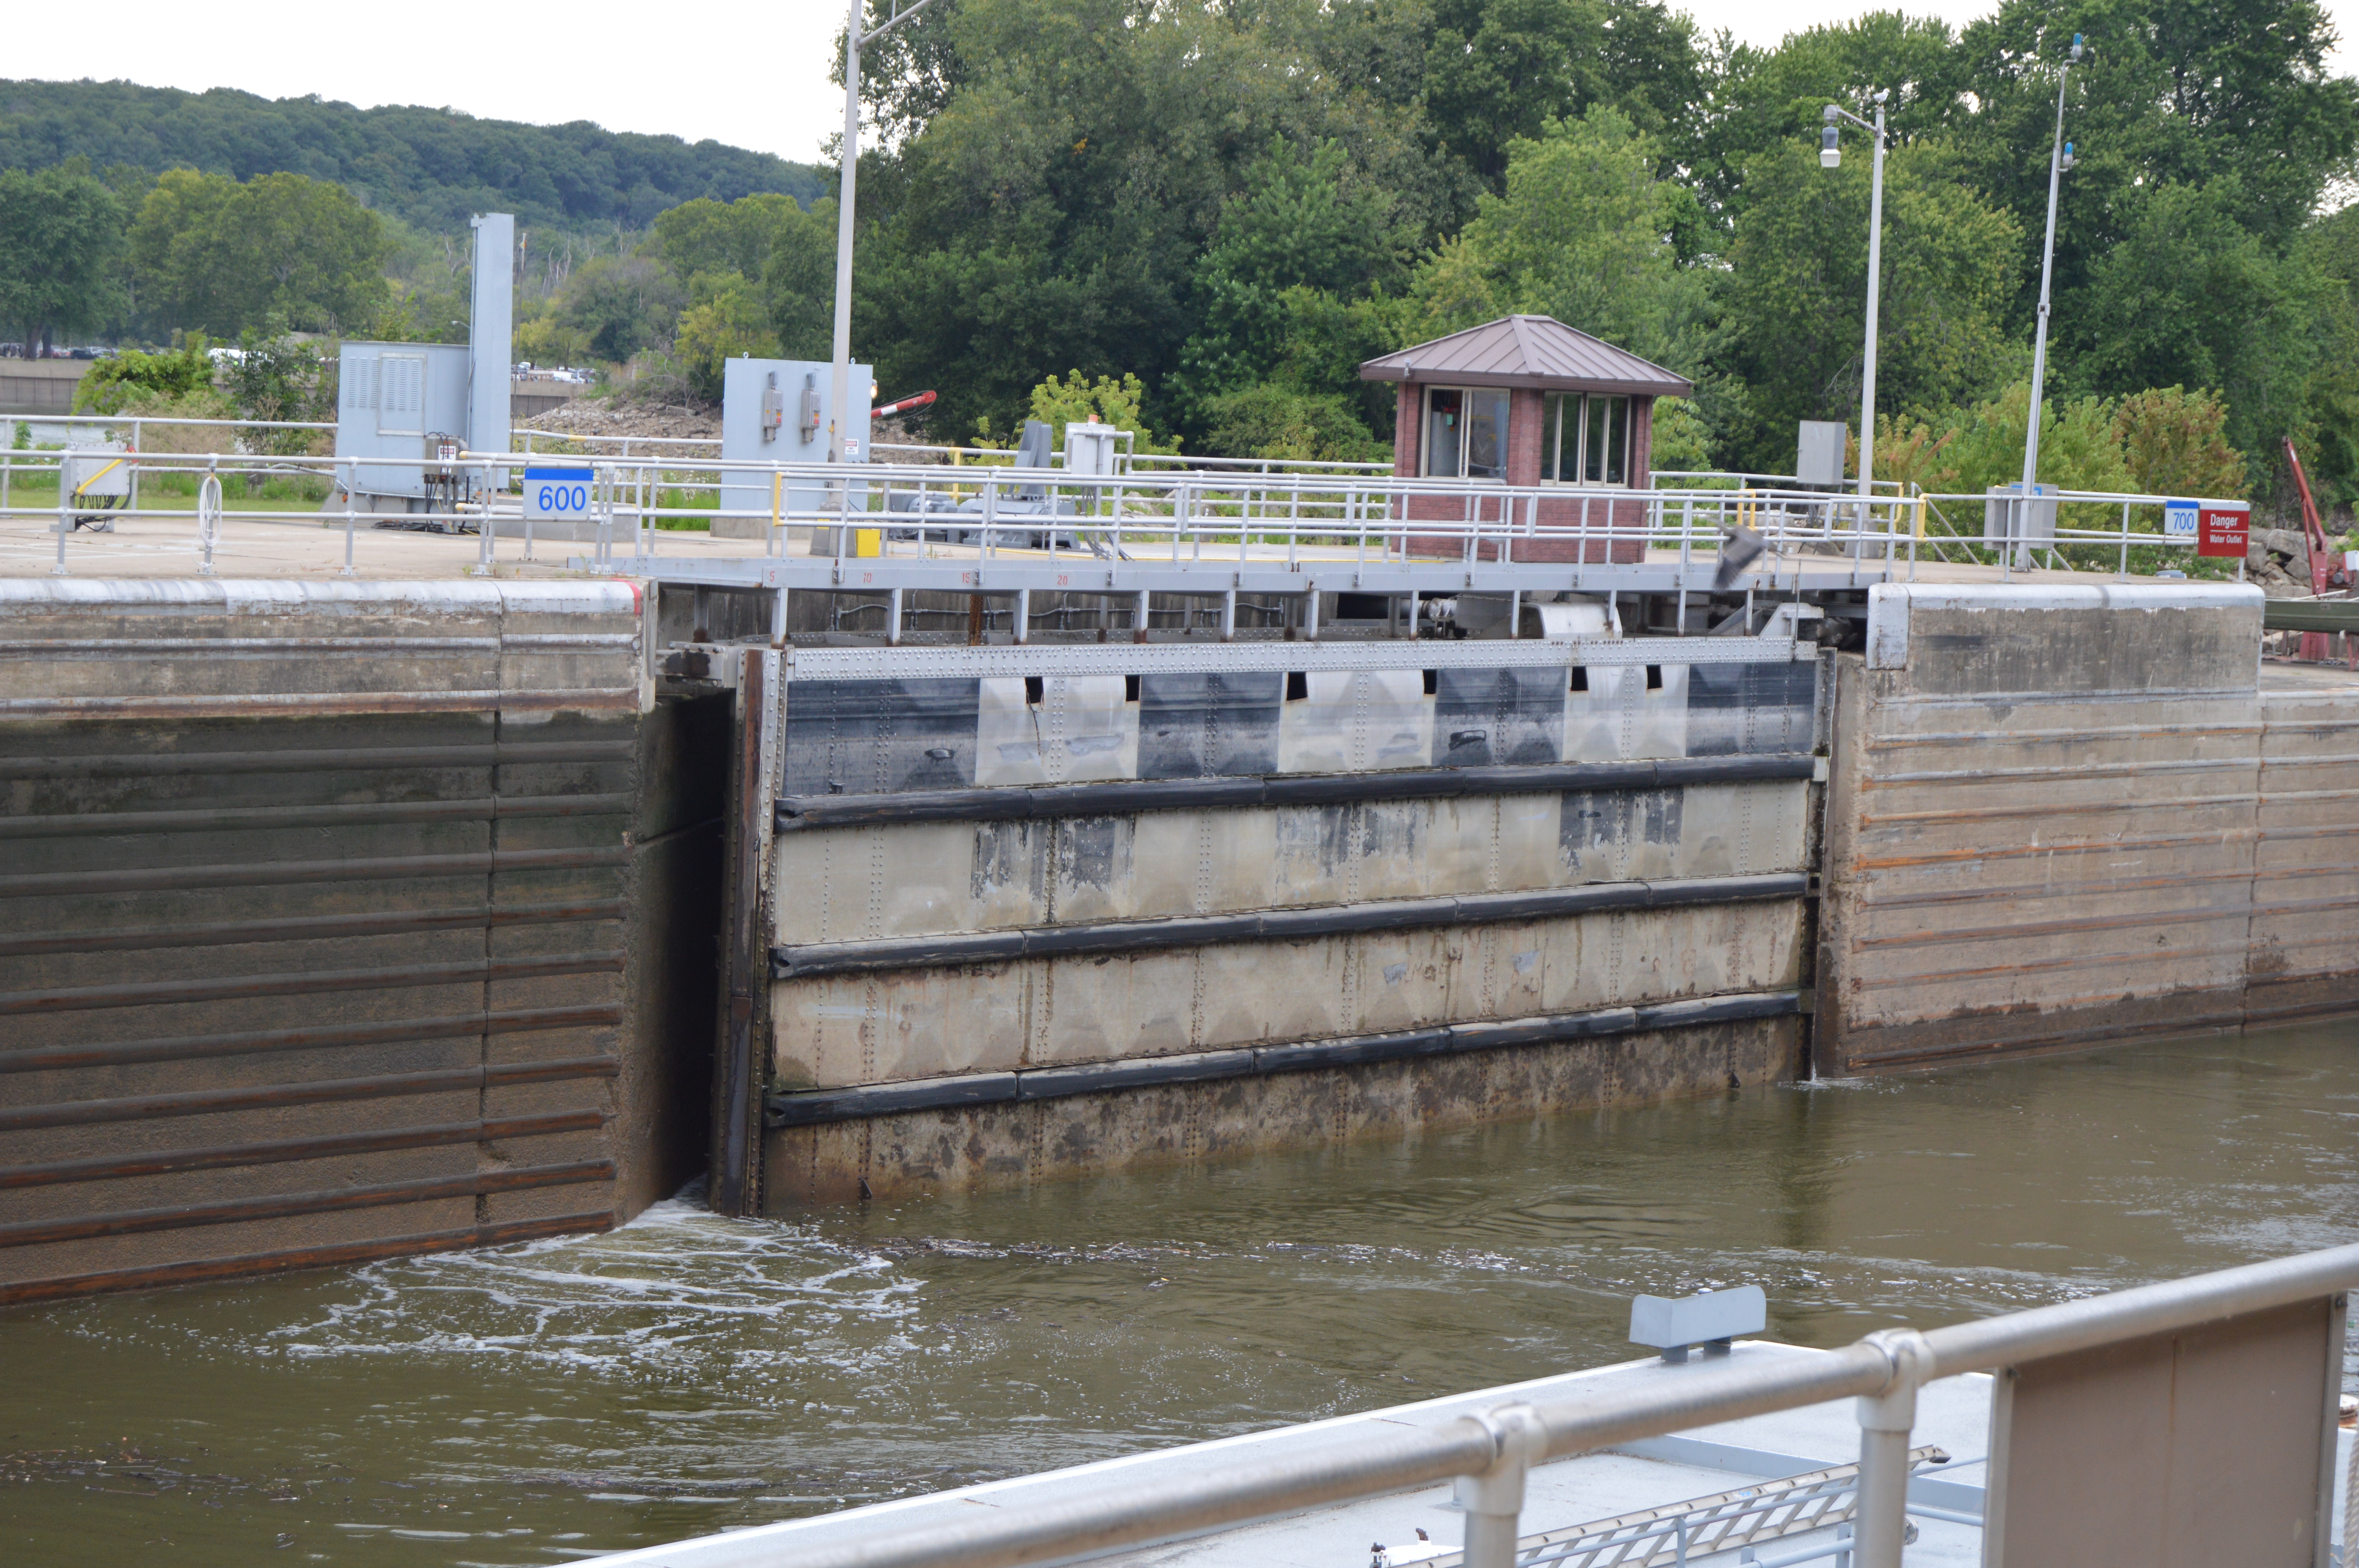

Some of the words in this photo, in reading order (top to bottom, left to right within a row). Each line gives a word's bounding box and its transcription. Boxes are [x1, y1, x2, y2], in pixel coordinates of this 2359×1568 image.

[539, 485, 586, 511] 600
[2174, 512, 2194, 530] 700
[2210, 514, 2238, 529] Danger
[2210, 534, 2225, 543] Water
[2226, 534, 2242, 543] Outlet
[770, 571, 775, 582] 5
[863, 573, 872, 583] 10
[962, 573, 970, 583] 15
[1058, 575, 1068, 585] 20
